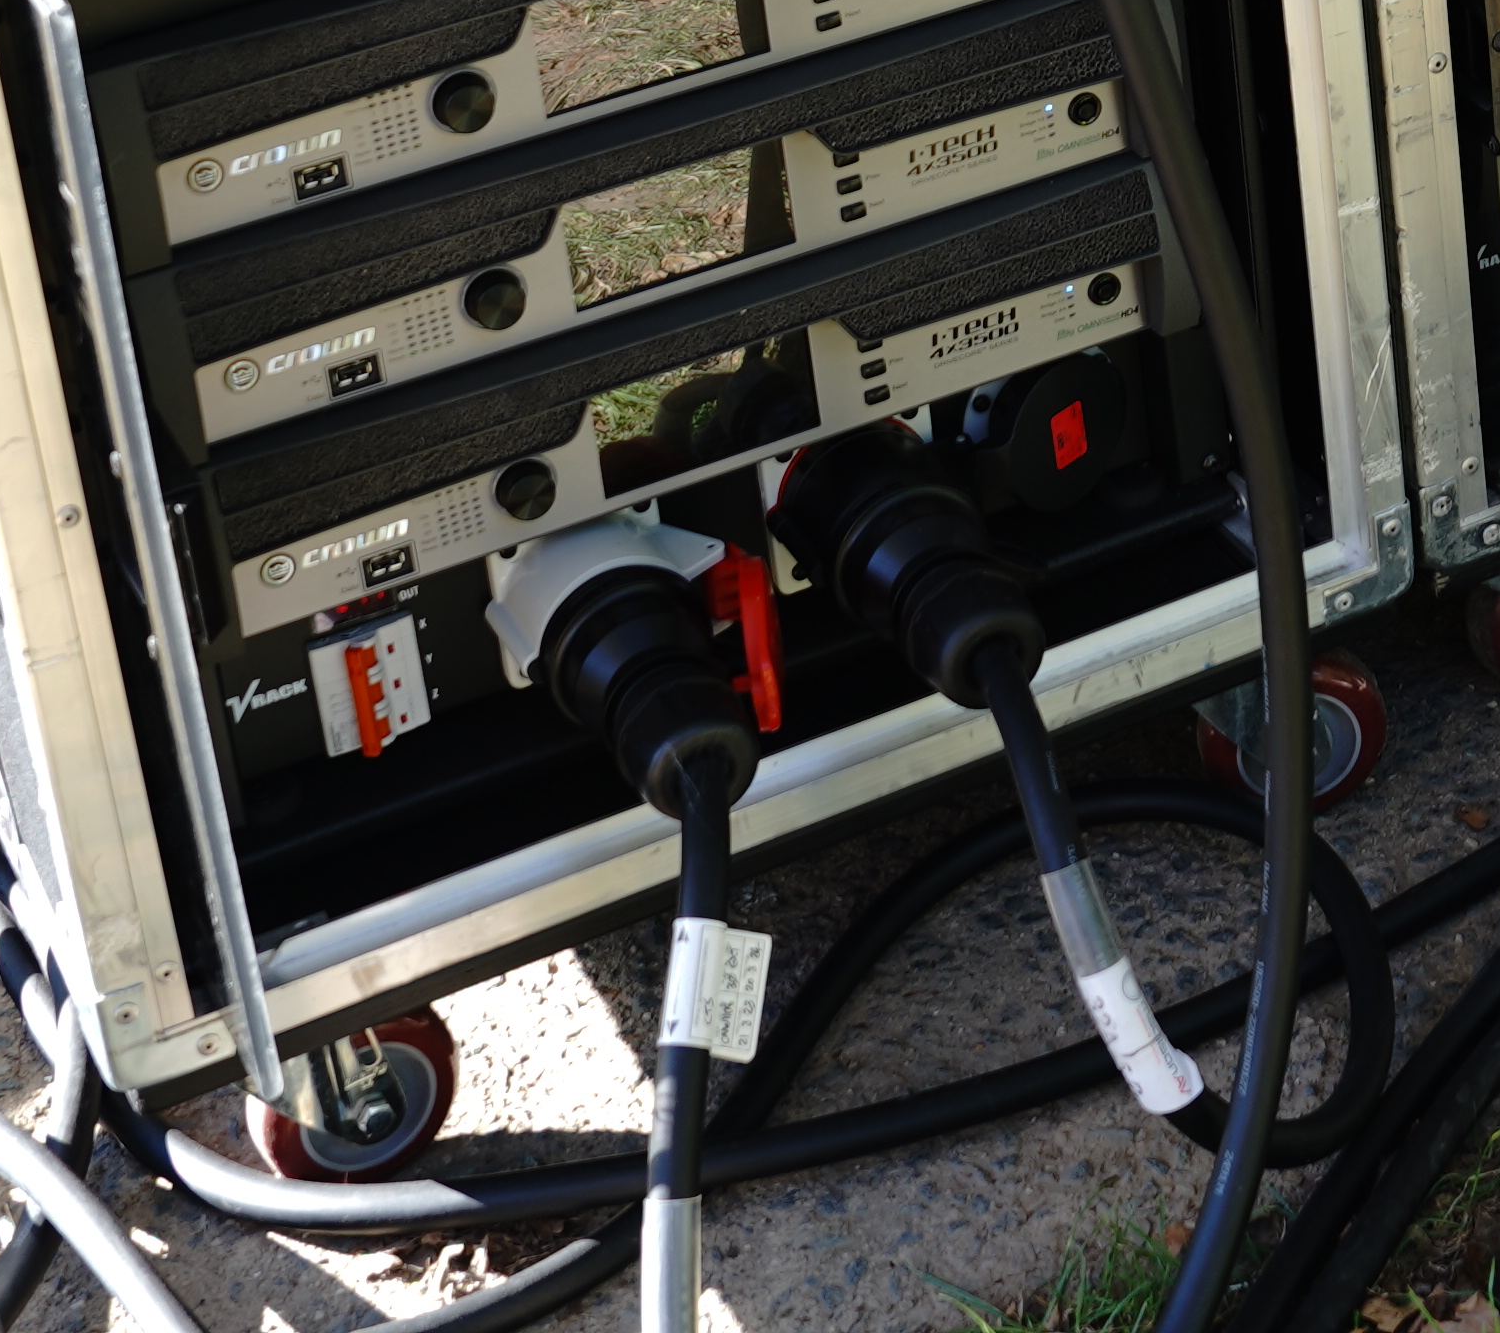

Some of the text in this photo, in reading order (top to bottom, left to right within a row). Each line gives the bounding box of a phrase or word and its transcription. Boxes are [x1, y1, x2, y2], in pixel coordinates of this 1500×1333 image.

[229, 128, 341, 175] crown
[266, 326, 376, 375] crown
[301, 518, 409, 569] crown
[398, 585, 419, 602] OUT
[419, 618, 428, 630] X
[425, 653, 433, 664] Y
[431, 688, 439, 700] Z
